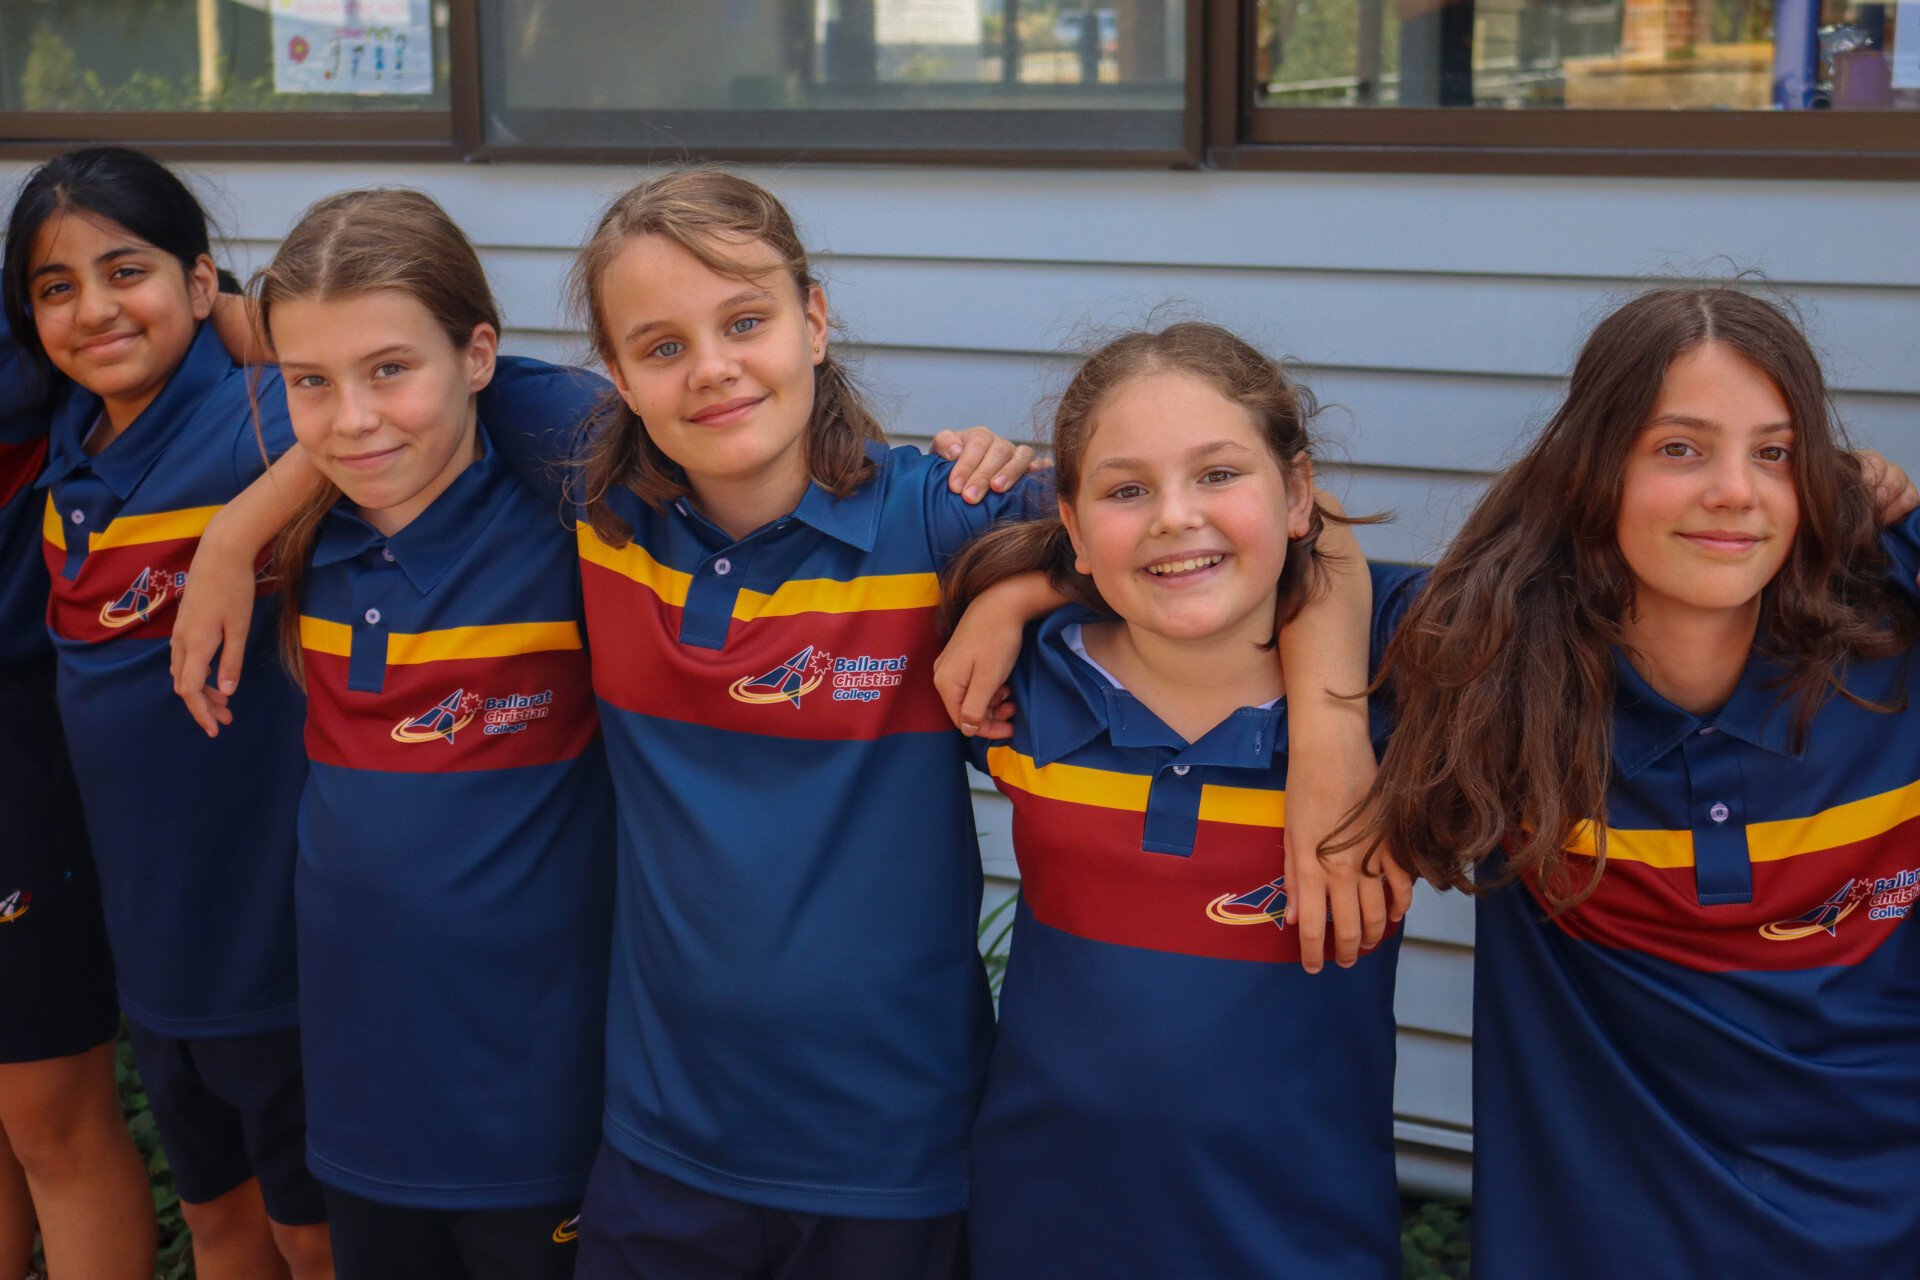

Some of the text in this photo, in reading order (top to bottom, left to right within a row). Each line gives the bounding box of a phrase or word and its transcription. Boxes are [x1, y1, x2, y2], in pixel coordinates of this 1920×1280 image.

[833, 655, 907, 672] Ballarat
[833, 672, 902, 688] Christian
[484, 689, 552, 710] Ballarat
[833, 688, 880, 702] College
[484, 707, 548, 723] Christian
[484, 722, 527, 735] College
[1872, 868, 1920, 896] Ballar
